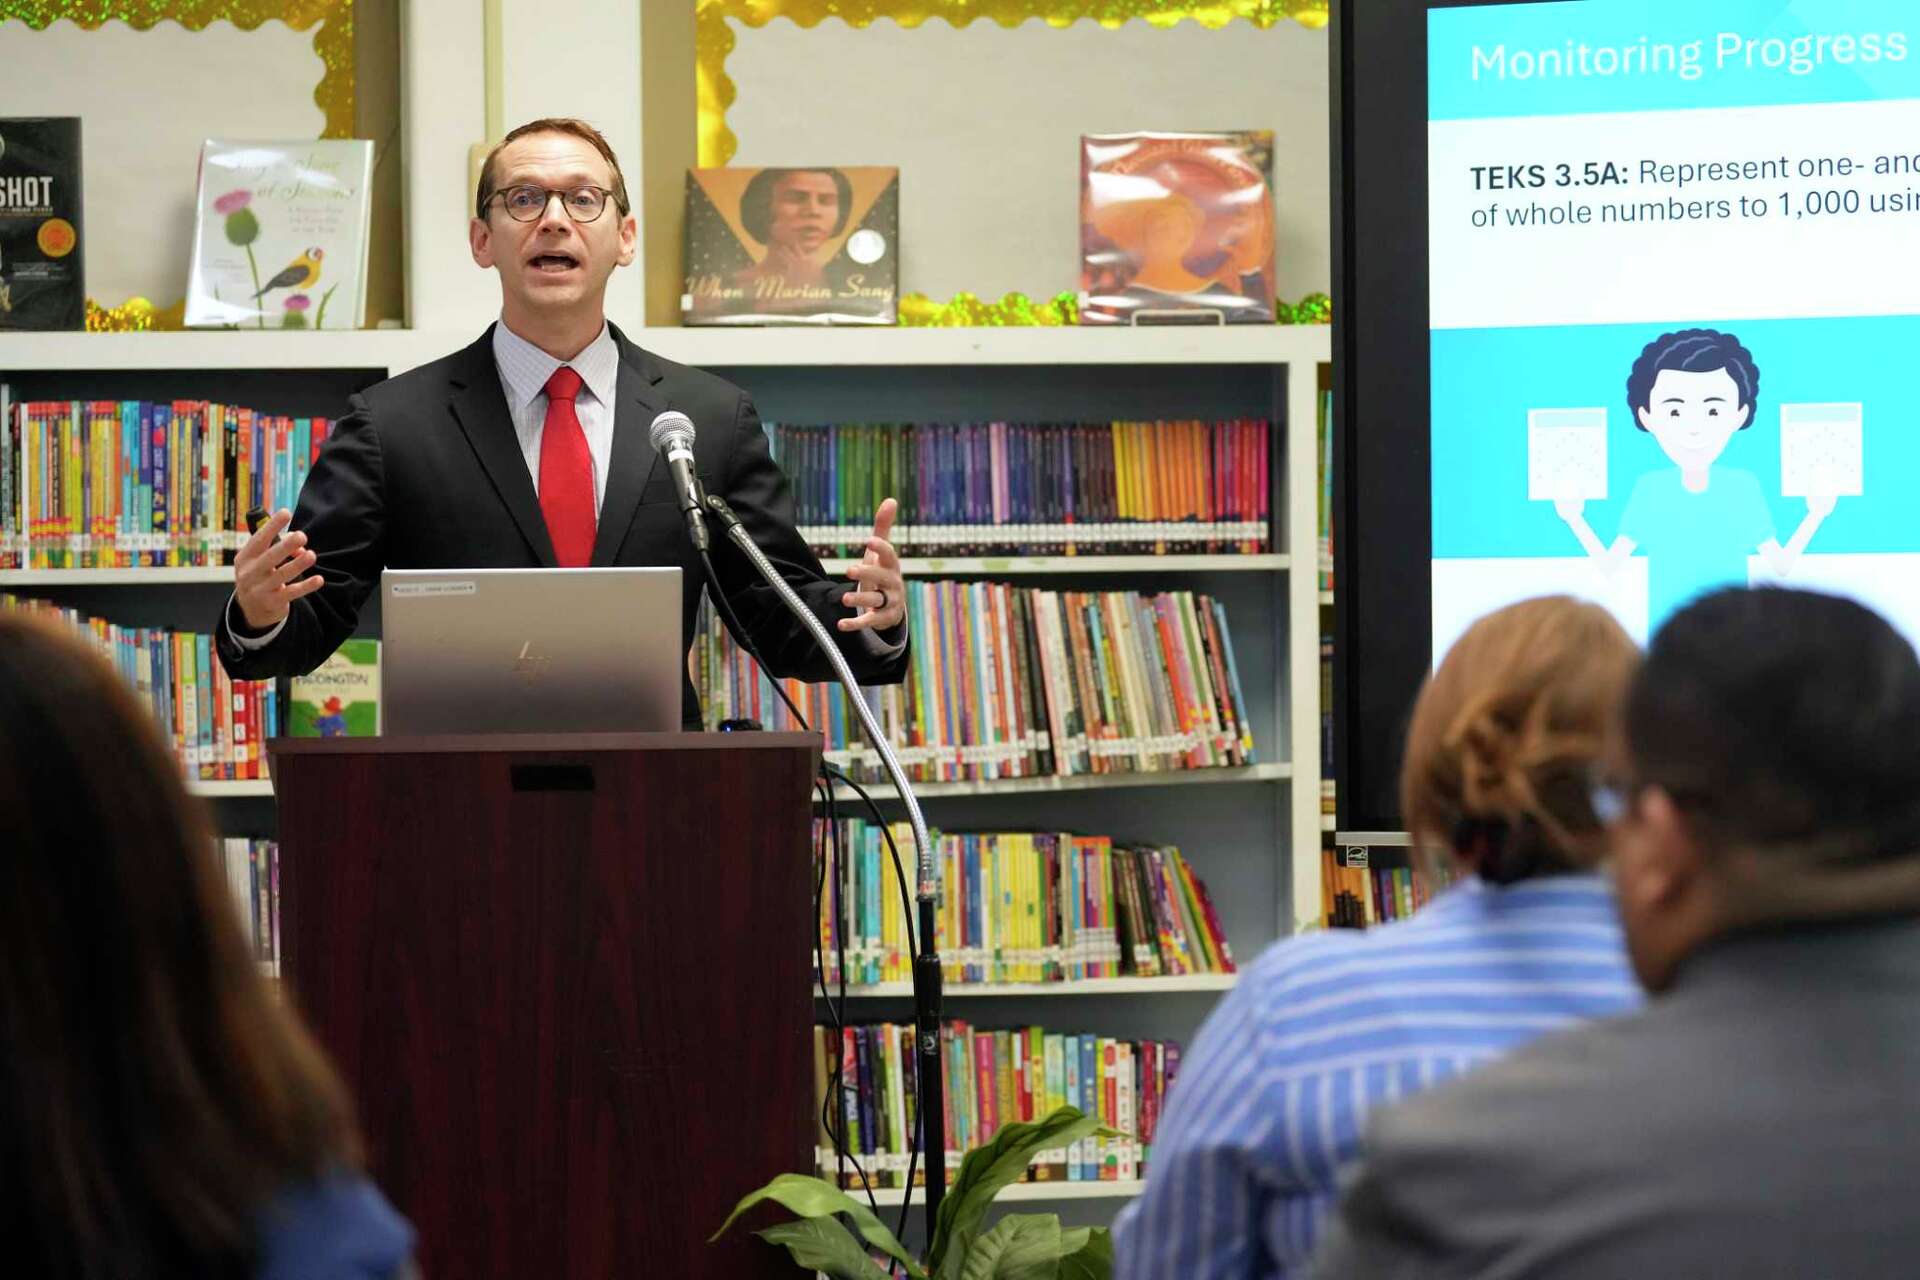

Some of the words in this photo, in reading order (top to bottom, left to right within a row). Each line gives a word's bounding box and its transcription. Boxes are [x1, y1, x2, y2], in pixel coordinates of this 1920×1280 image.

[1471, 37, 1703, 81] Monitoring
[1716, 31, 1908, 75] Progress
[1470, 164, 1546, 190] TEKS
[1555, 161, 1628, 187] 3.5A:
[1640, 156, 1790, 188] Represent
[1798, 156, 1865, 178] one-
[1471, 203, 1498, 228] of
[1506, 200, 1592, 226] whole
[1602, 196, 1731, 223] numbers
[1739, 195, 1768, 218] to
[1778, 189, 1860, 220] 1,000
[1870, 186, 1920, 212] usi
[685, 274, 744, 298] When
[754, 273, 833, 299] Marian
[837, 273, 895, 303] Sang
